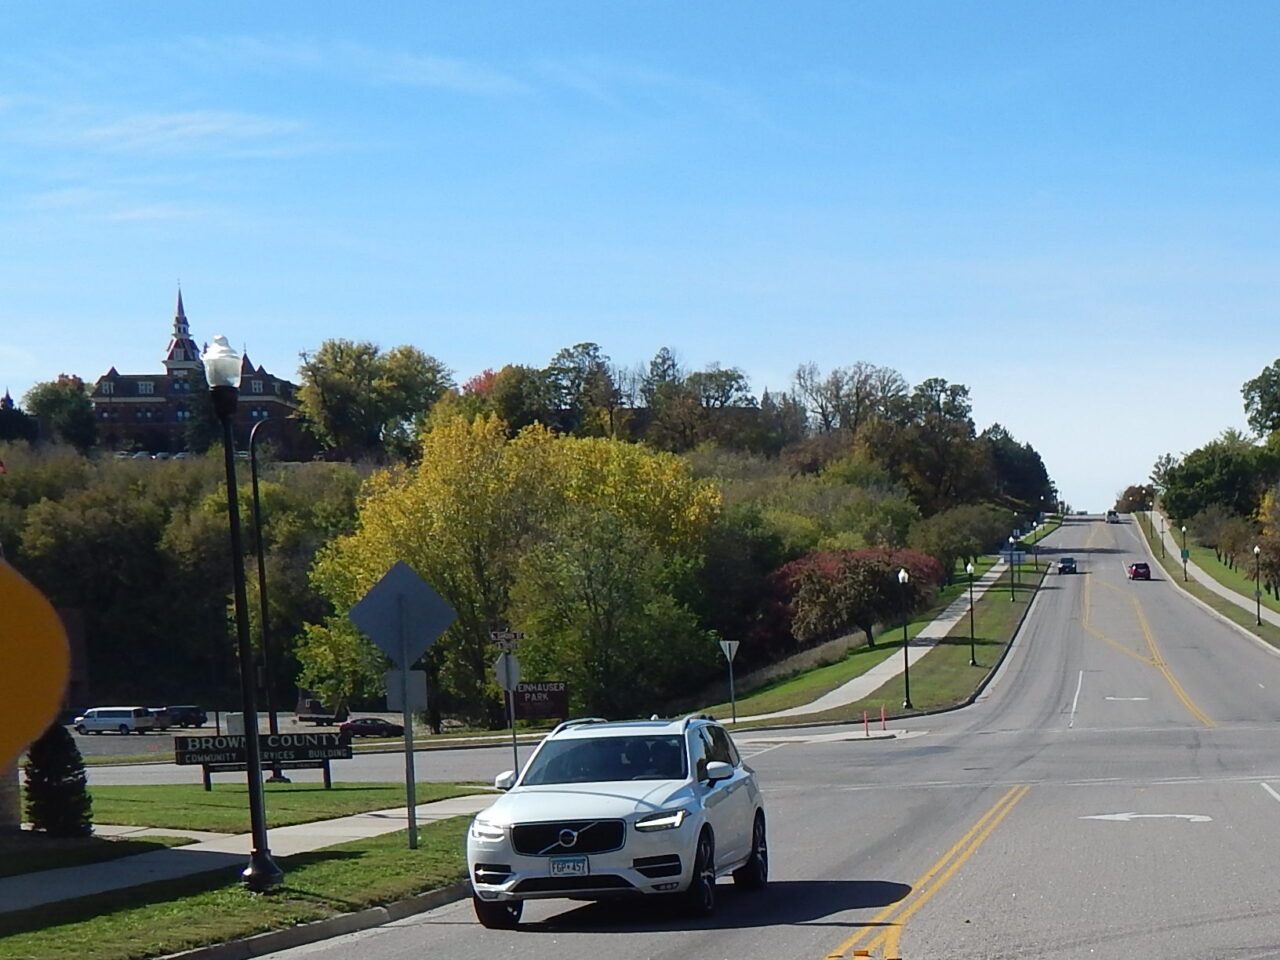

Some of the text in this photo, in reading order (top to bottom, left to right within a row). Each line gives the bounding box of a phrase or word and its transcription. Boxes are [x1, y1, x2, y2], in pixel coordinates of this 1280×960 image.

[525, 692, 549, 701] PARK
[267, 734, 342, 747] COUNTY
[185, 752, 237, 763] COMMUNITY
[308, 748, 348, 758] BUILDING
